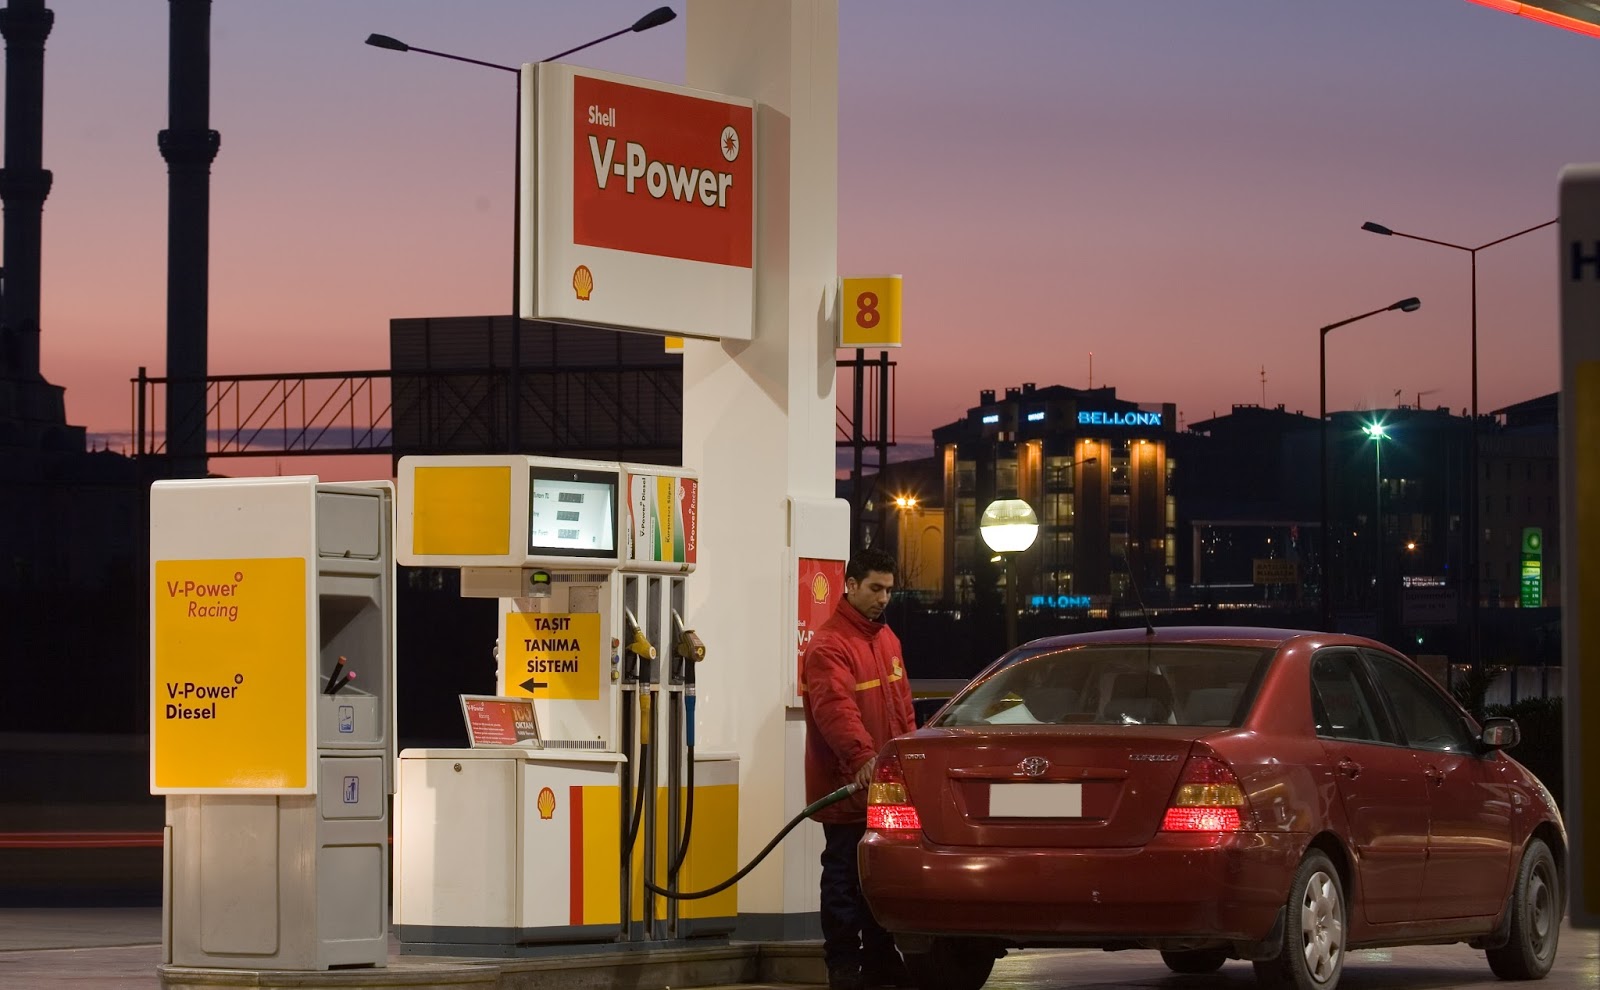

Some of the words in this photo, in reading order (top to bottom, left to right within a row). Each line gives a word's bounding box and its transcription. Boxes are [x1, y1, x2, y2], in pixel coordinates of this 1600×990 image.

[588, 105, 616, 128] Shell
[588, 135, 734, 209] V-Power
[856, 291, 880, 329] 8
[1078, 411, 1162, 426] BELLONA
[688, 510, 696, 551] V-Power
[166, 581, 238, 598] V-Power
[188, 601, 239, 622] Racing
[534, 617, 571, 634] TAŞIT
[524, 639, 580, 652] TANIMA
[527, 656, 578, 673] SİSTEMİ
[166, 682, 238, 699] V-Power
[166, 702, 216, 719] Diesel
